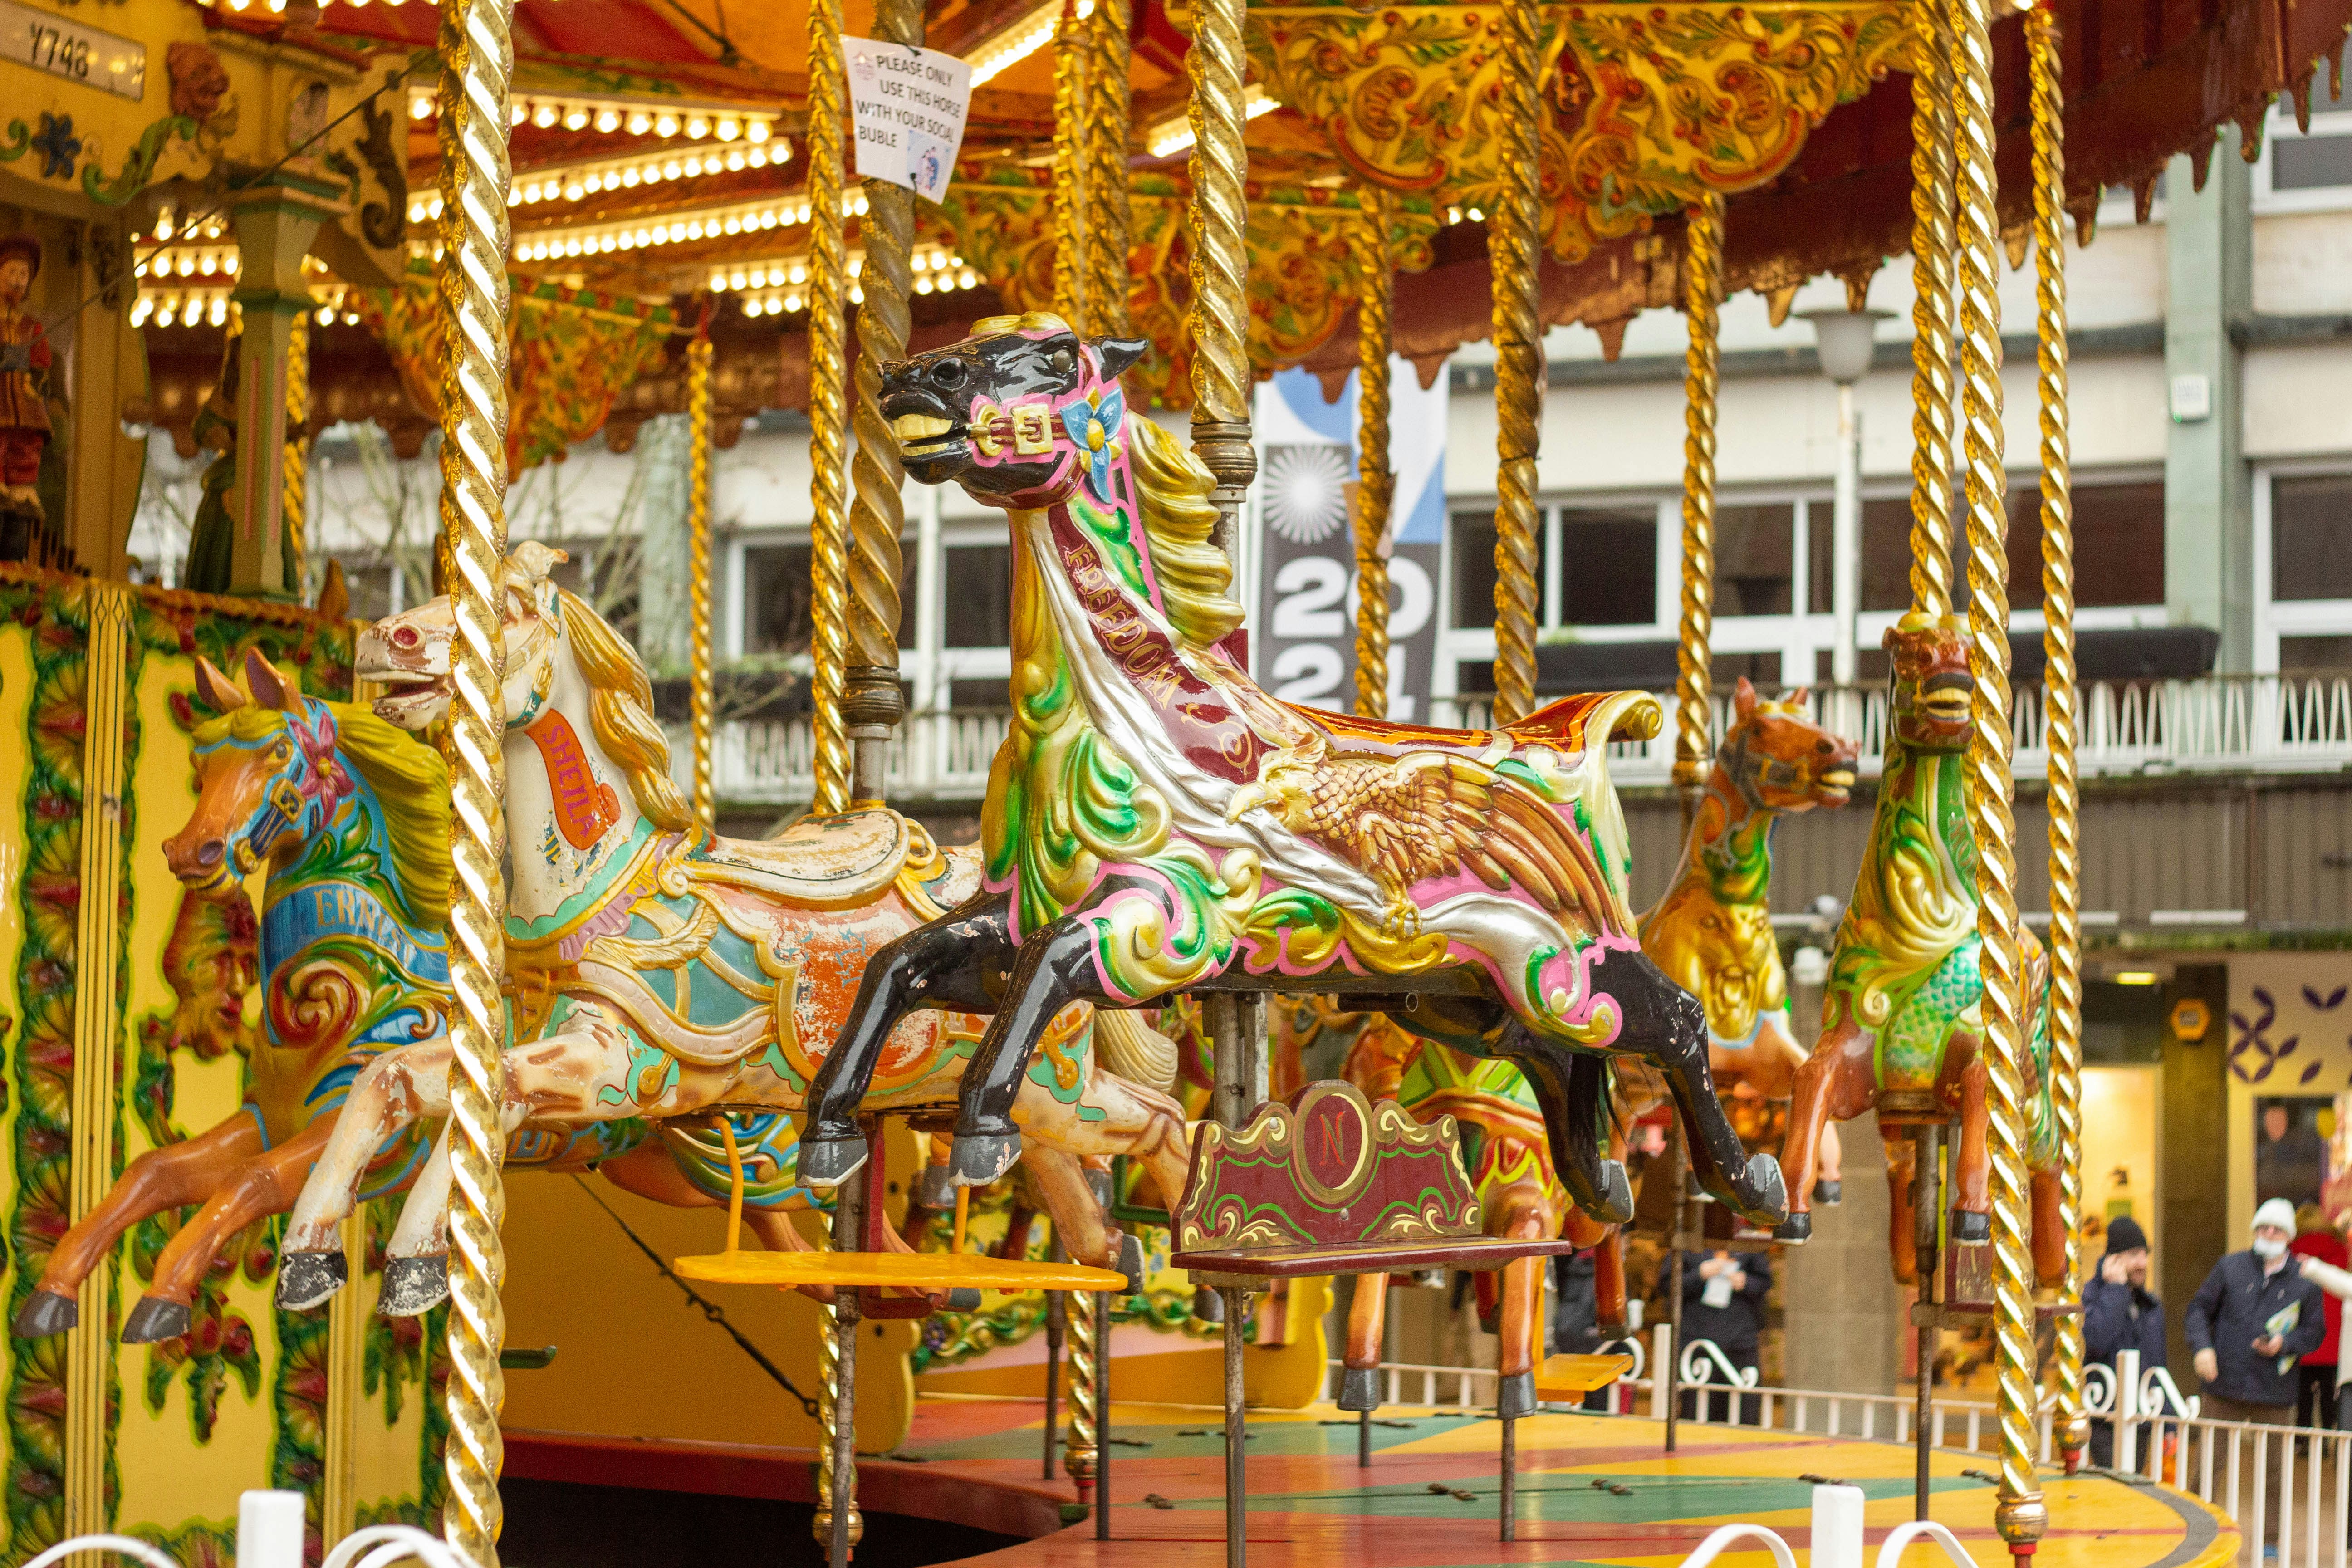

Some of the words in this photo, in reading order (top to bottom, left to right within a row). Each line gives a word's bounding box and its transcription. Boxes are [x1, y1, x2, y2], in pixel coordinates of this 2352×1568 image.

[876, 55, 922, 78] PLEASE
[926, 66, 954, 87] ONLY
[880, 79, 903, 98] USE
[907, 85, 930, 106] THIS
[933, 94, 961, 118] HORSE
[856, 99, 892, 120] WITH
[896, 109, 925, 131] YOUR
[927, 119, 953, 143] SOCIAL
[859, 125, 897, 147] BUBLE
[1064, 543, 1184, 711] FREEDOM
[543, 724, 597, 838] SHEILA
[1319, 1111, 1346, 1167] N
